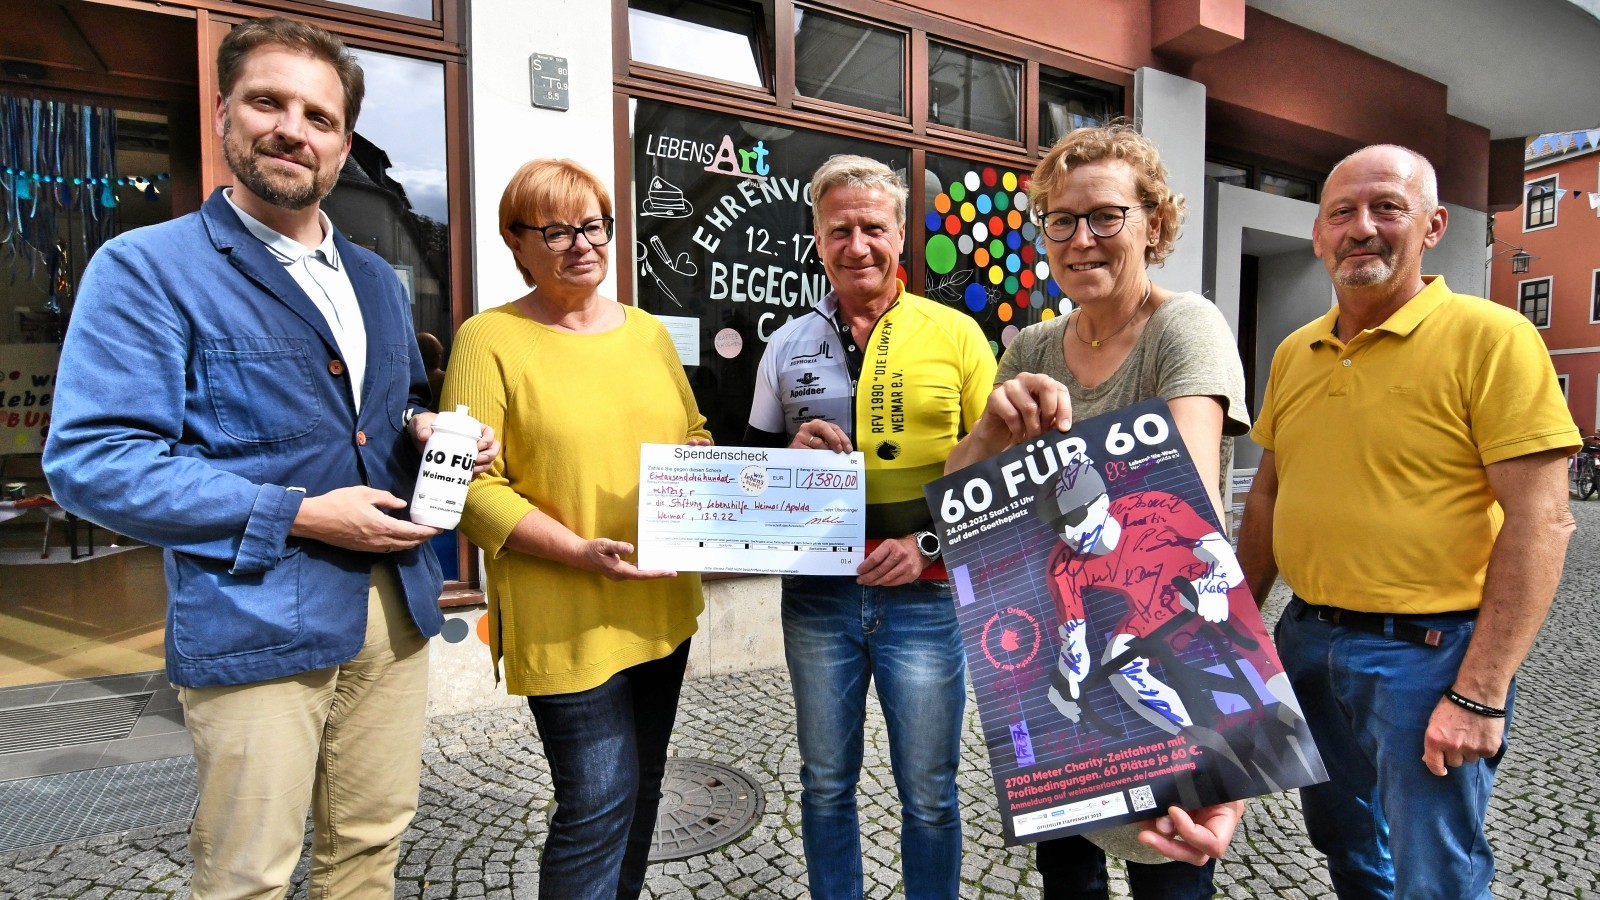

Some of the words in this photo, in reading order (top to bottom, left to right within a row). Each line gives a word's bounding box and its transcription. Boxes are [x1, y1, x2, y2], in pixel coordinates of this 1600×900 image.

[533, 59, 542, 71] S
[558, 67, 568, 76] 80
[891, 368, 904, 389] e.V.
[871, 384, 885, 411] 1990
[891, 391, 905, 434] WEIMAR
[871, 414, 885, 434] RFV
[425, 449, 446, 465] 60
[674, 447, 769, 462] Spendenscheck
[422, 470, 456, 483] Weimar
[940, 477, 993, 524] 60
[1001, 436, 1095, 498] FÜR
[1105, 413, 1169, 456] 60
[801, 472, 857, 490] 1380,00
[668, 498, 703, 511] Stiftung
[707, 500, 749, 515] Lebenshilfe
[946, 514, 989, 536] 24.08.2022
[988, 506, 1010, 519] Start
[1010, 501, 1020, 510] 13
[1019, 495, 1035, 506] Uhr
[948, 535, 962, 545] auf
[962, 529, 980, 540] dem
[980, 509, 1029, 532] Goetheplatz
[1006, 606, 1036, 623] Original
[1001, 664, 1015, 672] der
[1005, 774, 1031, 789] 2700
[1032, 767, 1063, 782] Meter
[1064, 742, 1165, 774] Charity-Zeitfahren
[1167, 735, 1187, 748] mit
[1007, 771, 1102, 800] Profibedingungen.
[1103, 765, 1118, 777] 60
[1119, 757, 1156, 773] Plätze
[1156, 753, 1169, 766] je
[1171, 748, 1187, 761] 60
[1188, 744, 1203, 756] €.
[1010, 795, 1053, 811] Anmeldung
[1053, 791, 1067, 801] auf
[1068, 761, 1197, 797] weimarerloewen.de/anmeldung
